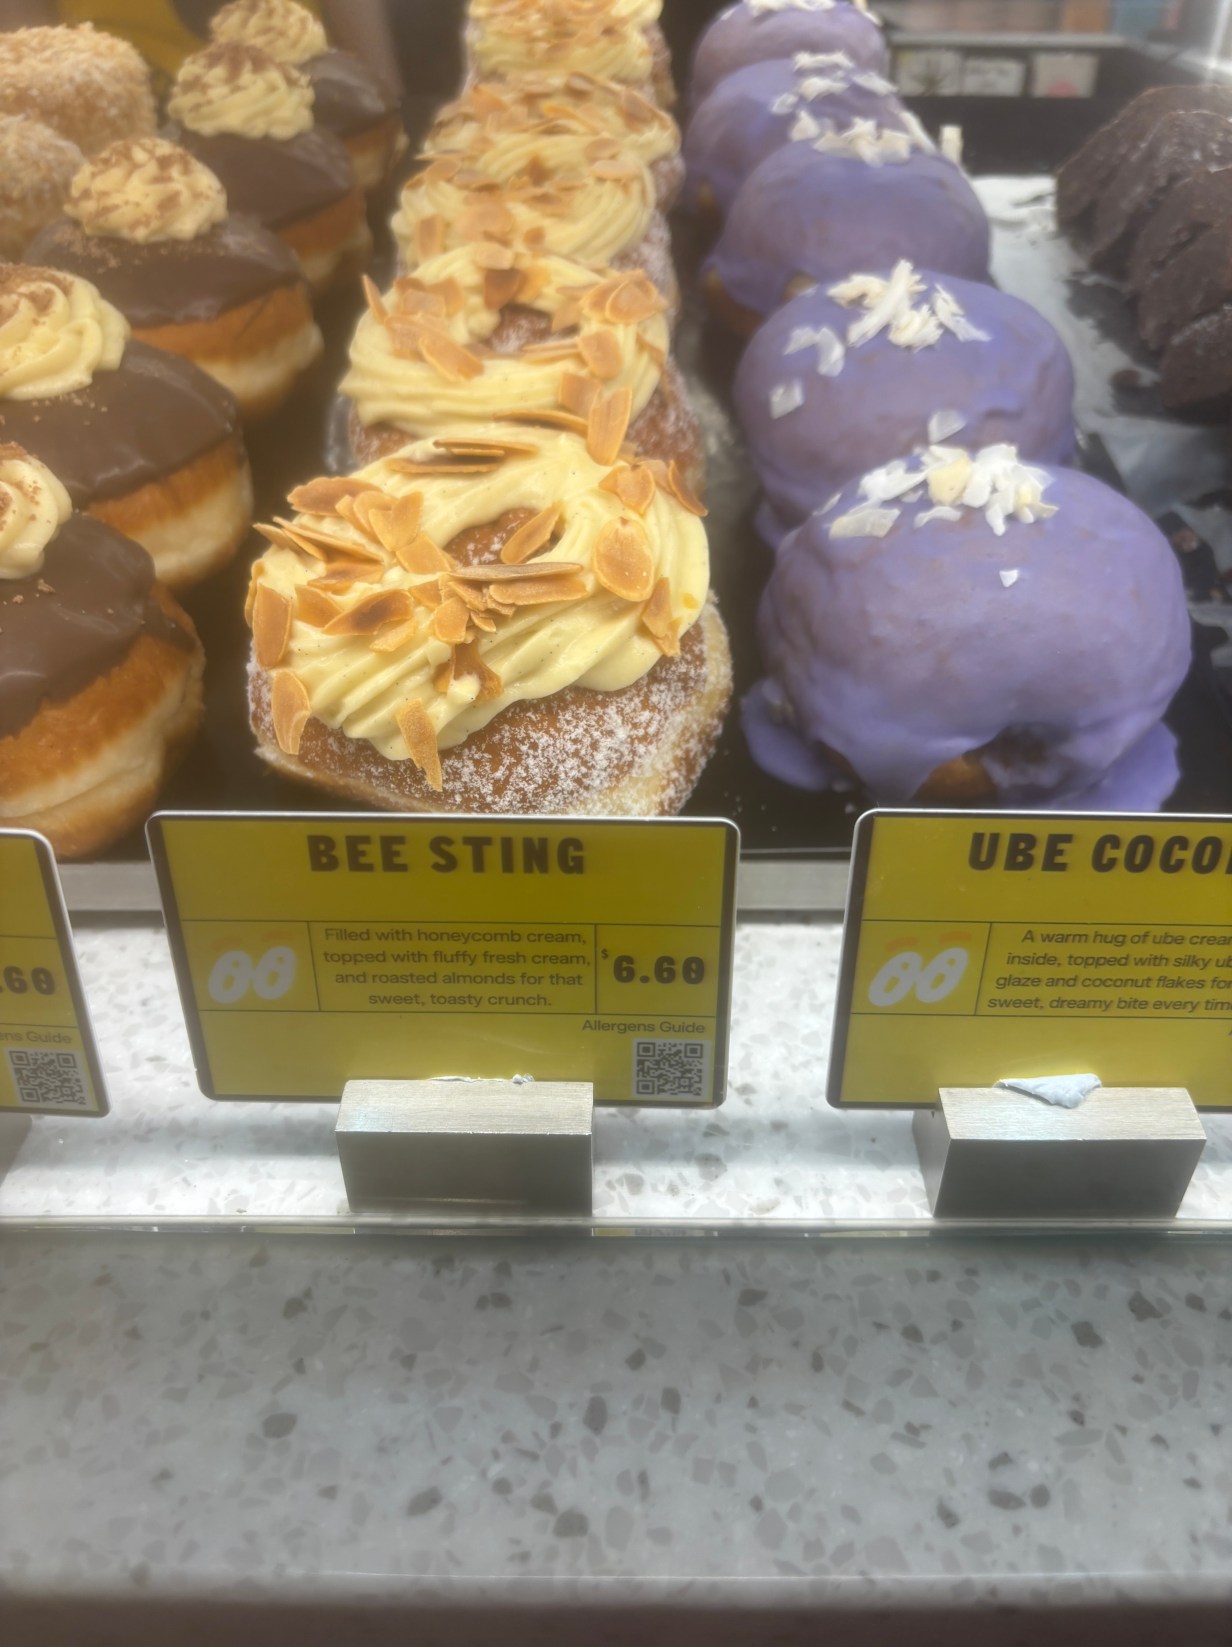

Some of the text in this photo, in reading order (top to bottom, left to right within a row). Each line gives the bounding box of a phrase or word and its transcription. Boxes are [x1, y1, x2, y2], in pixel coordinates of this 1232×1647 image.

[307, 835, 585, 875] BEE STING
[968, 832, 1232, 875] UBE COCO
[324, 928, 587, 945] Filled with honeycomb cream,
[1021, 929, 1035, 943] A
[1040, 932, 1089, 944] warm
[1092, 931, 1126, 947] hug
[1130, 931, 1150, 945] of
[1152, 931, 1185, 945] ube
[323, 952, 591, 967] topped with fluffy fresh cream,
[1006, 952, 1232, 970] inside, topped with silky ub
[335, 971, 583, 986] and roasted almonds for that
[995, 974, 1041, 990] glaze
[1045, 975, 1078, 988] and
[1081, 975, 1152, 988] coconut
[1156, 975, 1206, 989] flakes
[368, 993, 552, 1008] sweet, toasty crunch.
[987, 997, 1044, 1010] sweet,
[1049, 996, 1112, 1012] dreamy
[1116, 997, 1149, 1010] bite
[1152, 999, 1199, 1013] every
[582, 1020, 706, 1034] Allergens Guide
[26, 1031, 72, 1043] Guide
